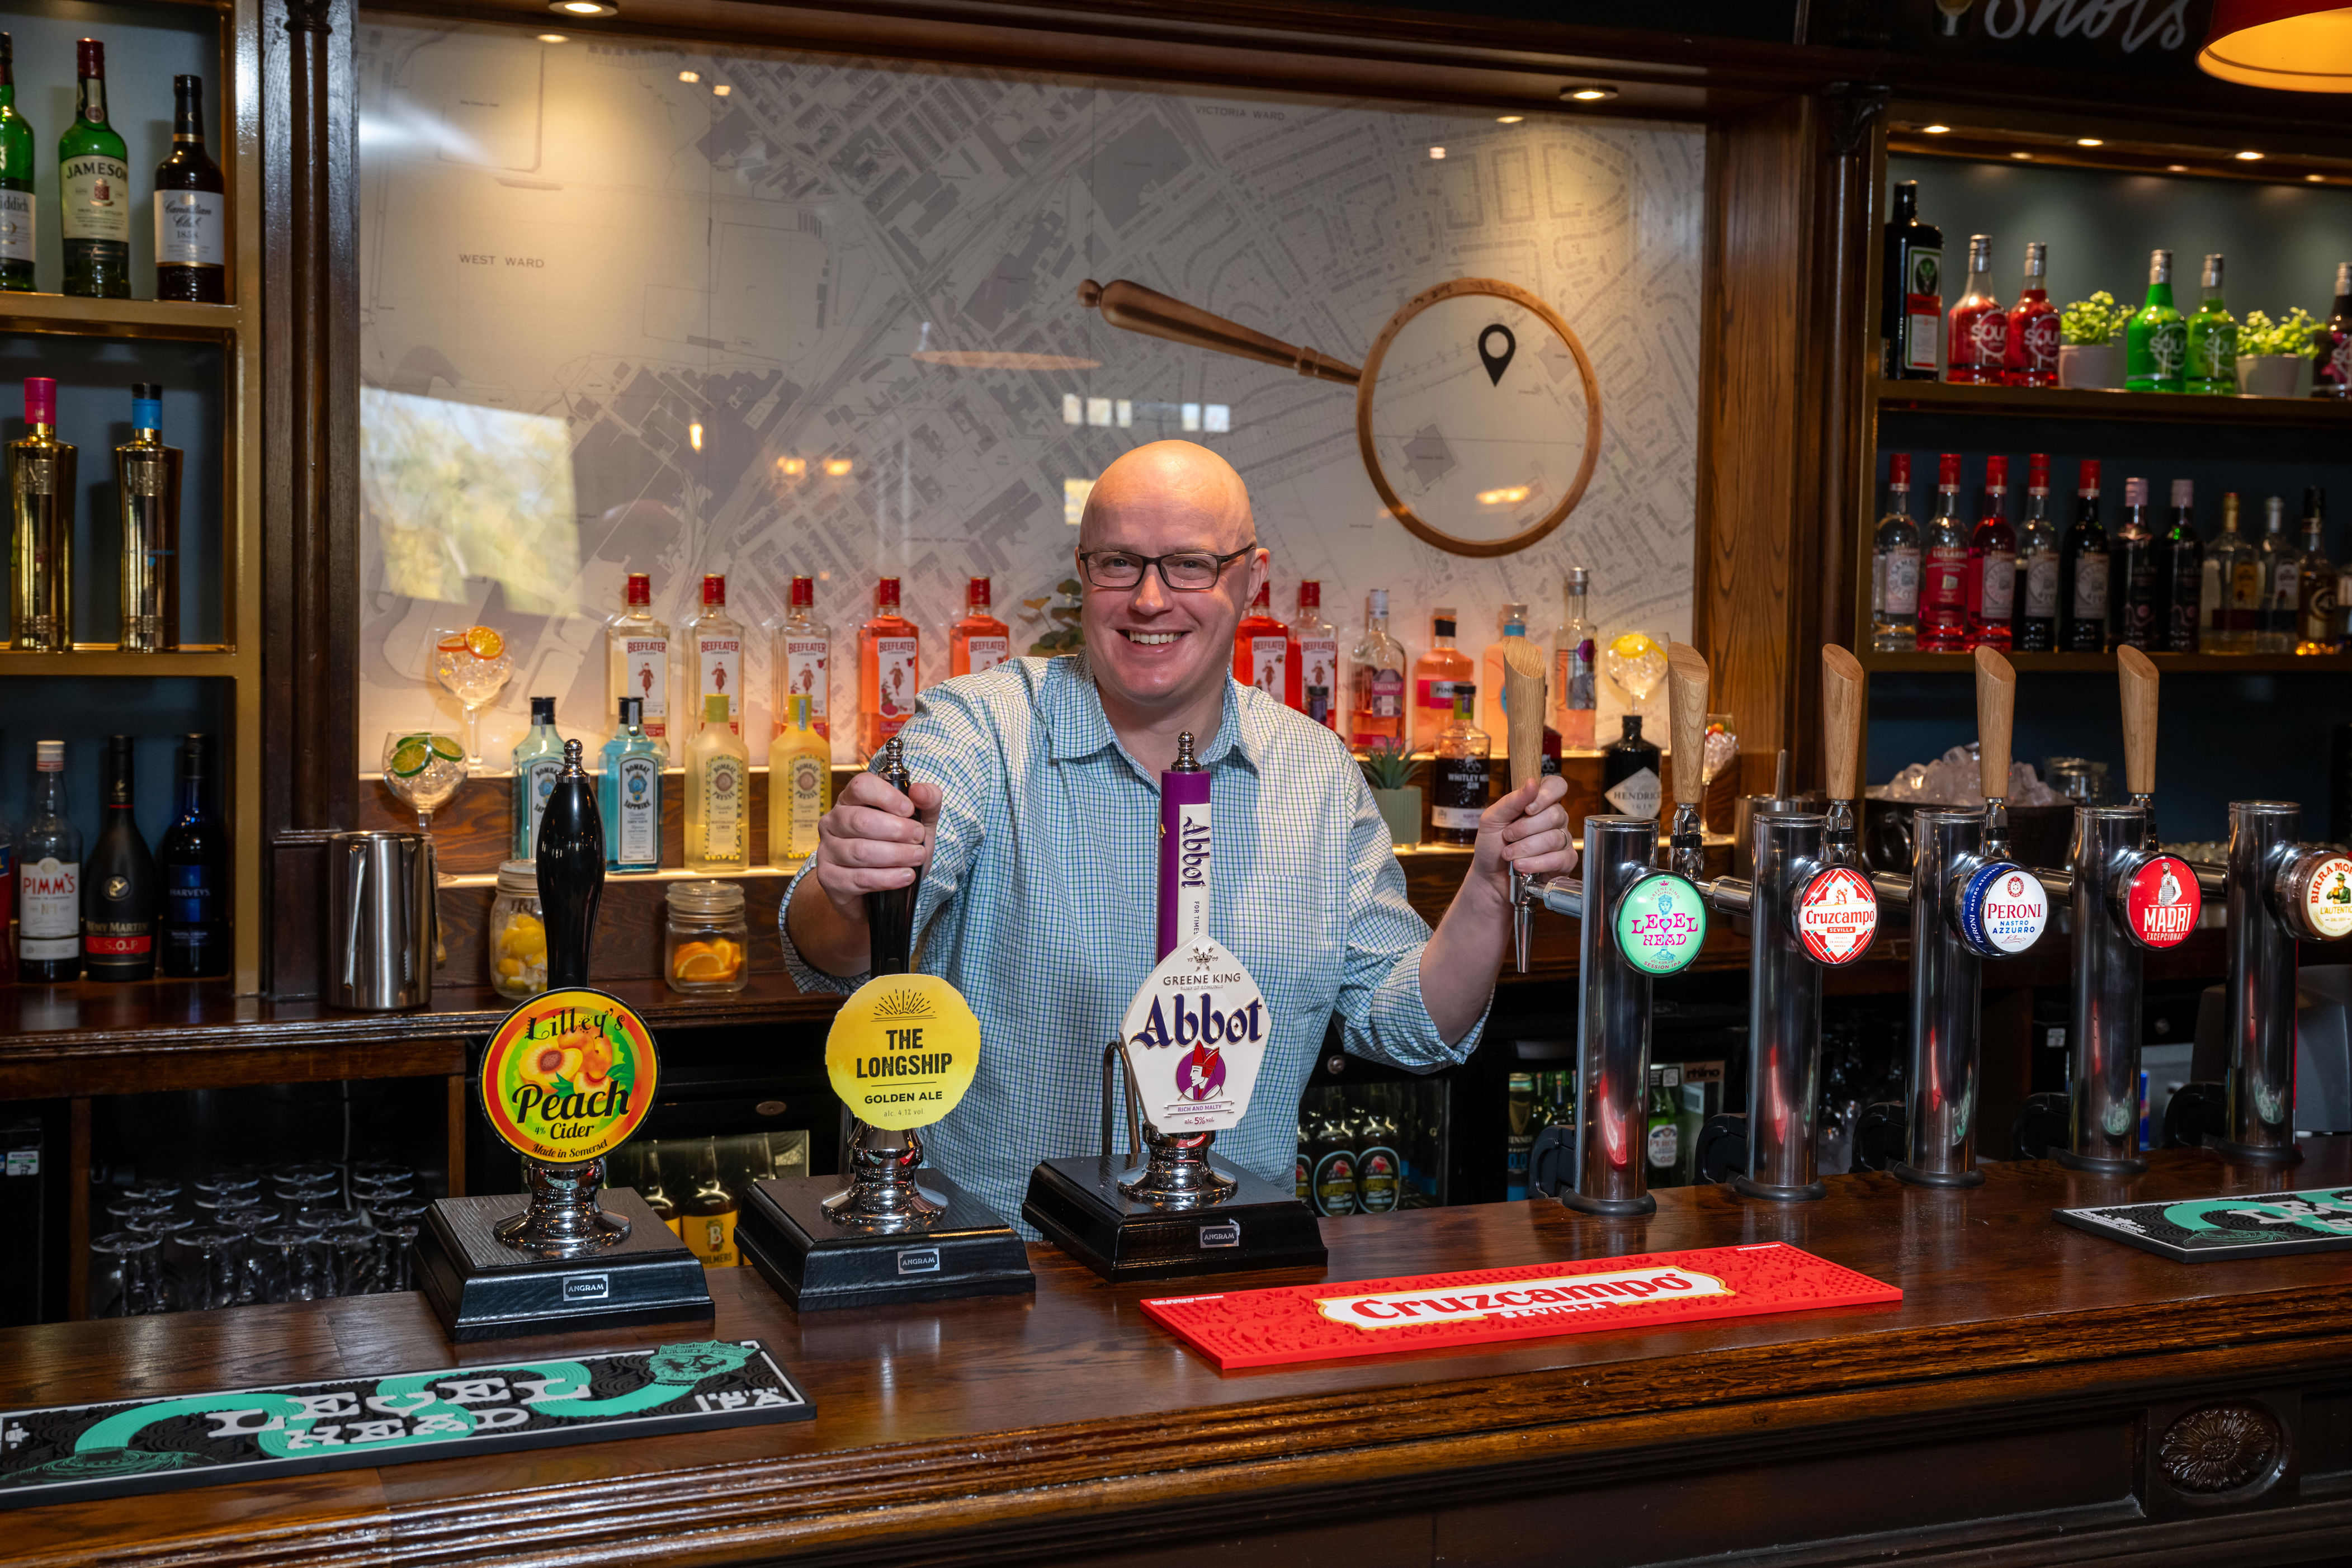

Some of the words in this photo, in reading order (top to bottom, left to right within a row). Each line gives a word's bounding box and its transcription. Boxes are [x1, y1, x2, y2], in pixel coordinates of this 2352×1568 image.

[1196, 105, 1246, 117] VICTORIA
[1253, 110, 1285, 121] WARD
[459, 253, 496, 266] WEST
[505, 257, 545, 269] WARD
[628, 641, 666, 653] BEEFEATER
[701, 640, 739, 653] BEEFEATER
[788, 641, 826, 653] BEEFEATER
[879, 641, 915, 653] BEEFEATER
[970, 641, 1006, 653] BEEFEATER
[1180, 815, 1211, 889] Abbot
[1979, 867, 2000, 886] AZZURRO
[169, 888, 211, 896] HARVEYS
[2311, 866, 2334, 904] BIRRA
[1970, 887, 1980, 911] NASTRO
[1806, 909, 1874, 925] Cruzcampo
[1987, 903, 2042, 919] PERONI
[1631, 913, 1698, 934] LEVEL
[1969, 914, 1983, 943] PERONI
[1643, 933, 1687, 946] HEAD
[2146, 932, 2183, 941] EXCEPCIONAL
[1643, 961, 1670, 970] SESSION
[1163, 975, 1208, 986] GREENE
[1212, 972, 1241, 983] KING
[525, 1007, 626, 1041] Lilley's
[1128, 993, 1263, 1050] Abbot
[885, 1028, 923, 1050] THE
[856, 1053, 953, 1079] LONGSHIP
[512, 1080, 630, 1124] Peach
[864, 1093, 915, 1104] GOLDEN
[918, 1090, 943, 1101] ALE
[1194, 1116, 1206, 1125] 5%
[534, 1126, 546, 1135] 4%
[550, 1122, 595, 1140] Cider
[531, 1143, 556, 1158] Made
[558, 1149, 566, 1158] in
[569, 1138, 608, 1158] Somerset
[709, 1226, 723, 1245] B
[902, 1257, 935, 1266] ANGRAM
[568, 1283, 604, 1292] ANGRAM
[1351, 1272, 1693, 1319] Cruzcampo
[1500, 1302, 1607, 1319] SEVILLA
[205, 1377, 592, 1438] LEVEL
[695, 1392, 790, 1412] IPA
